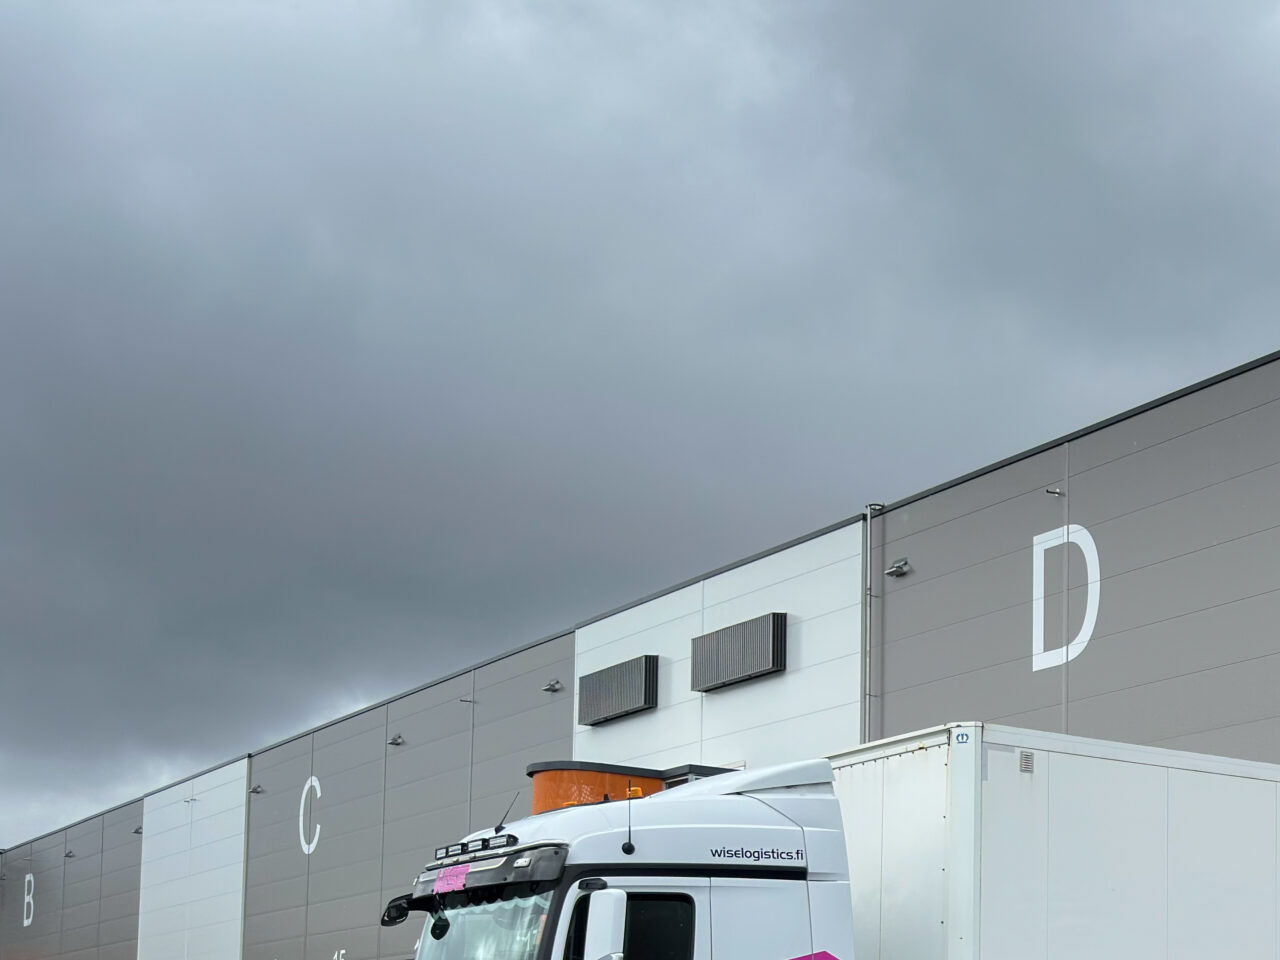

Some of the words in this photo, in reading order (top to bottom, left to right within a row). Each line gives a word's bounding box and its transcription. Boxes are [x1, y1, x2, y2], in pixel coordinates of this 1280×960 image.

[1033, 524, 1100, 671] D
[299, 776, 321, 854] C
[710, 847, 803, 861] wiselogistics.fi
[24, 873, 34, 927] B
